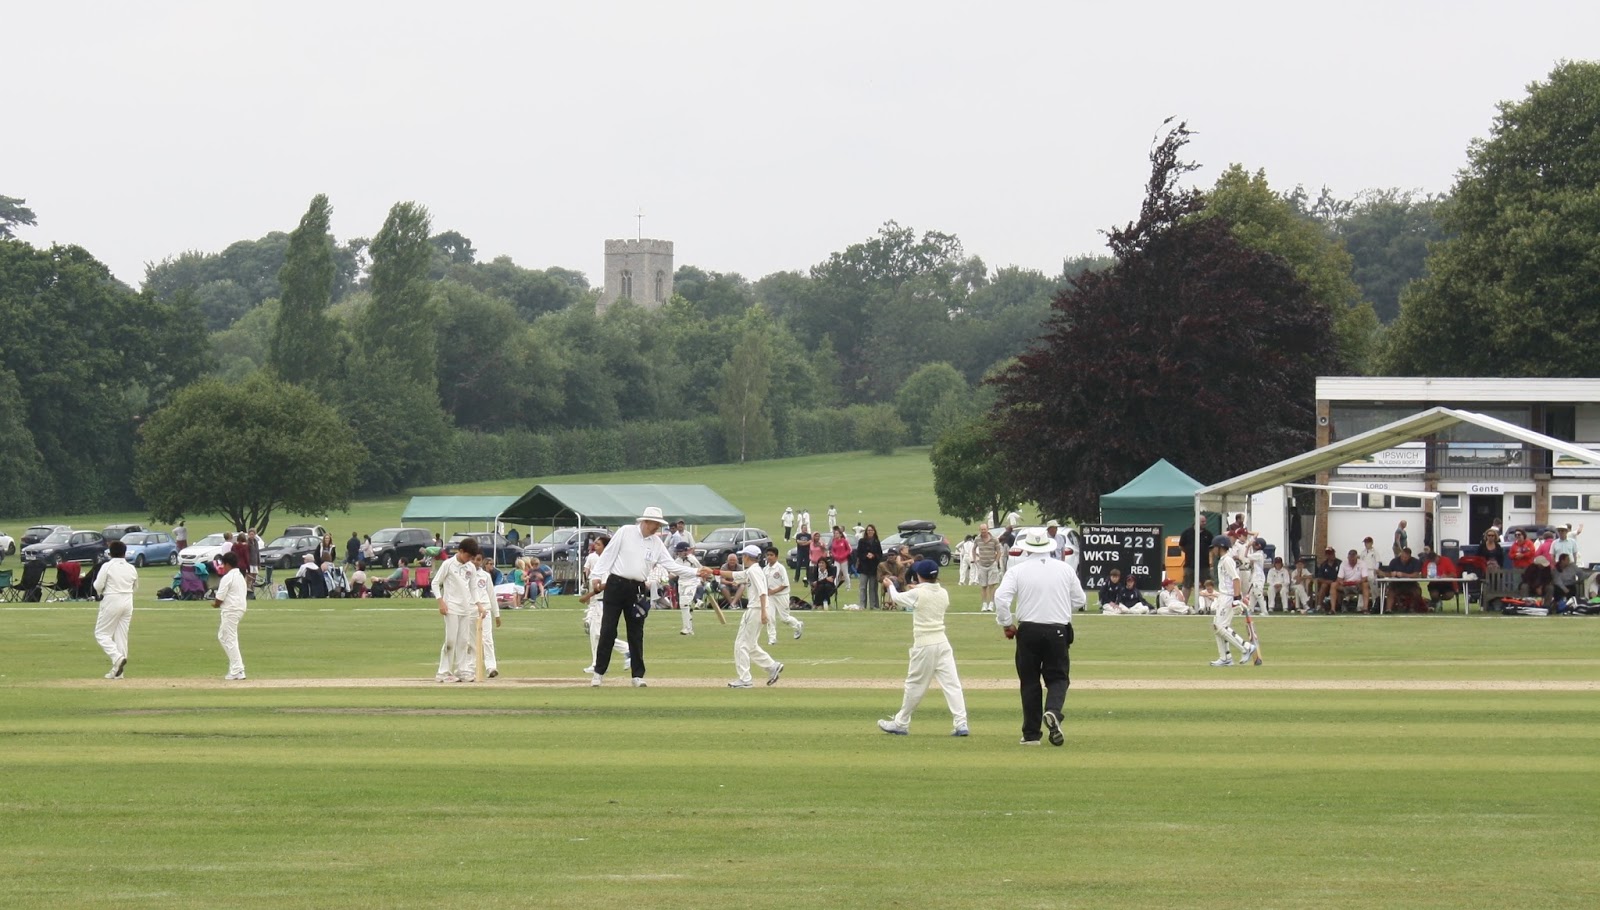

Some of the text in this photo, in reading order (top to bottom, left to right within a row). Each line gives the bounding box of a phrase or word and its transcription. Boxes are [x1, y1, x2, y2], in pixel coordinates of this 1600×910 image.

[1382, 451, 1419, 459] IPSWICH
[1471, 484, 1499, 492] Gents
[1083, 534, 1121, 545] TOTAL
[1083, 550, 1143, 565] WKTS 7
[1089, 565, 1149, 575] OV REQ
